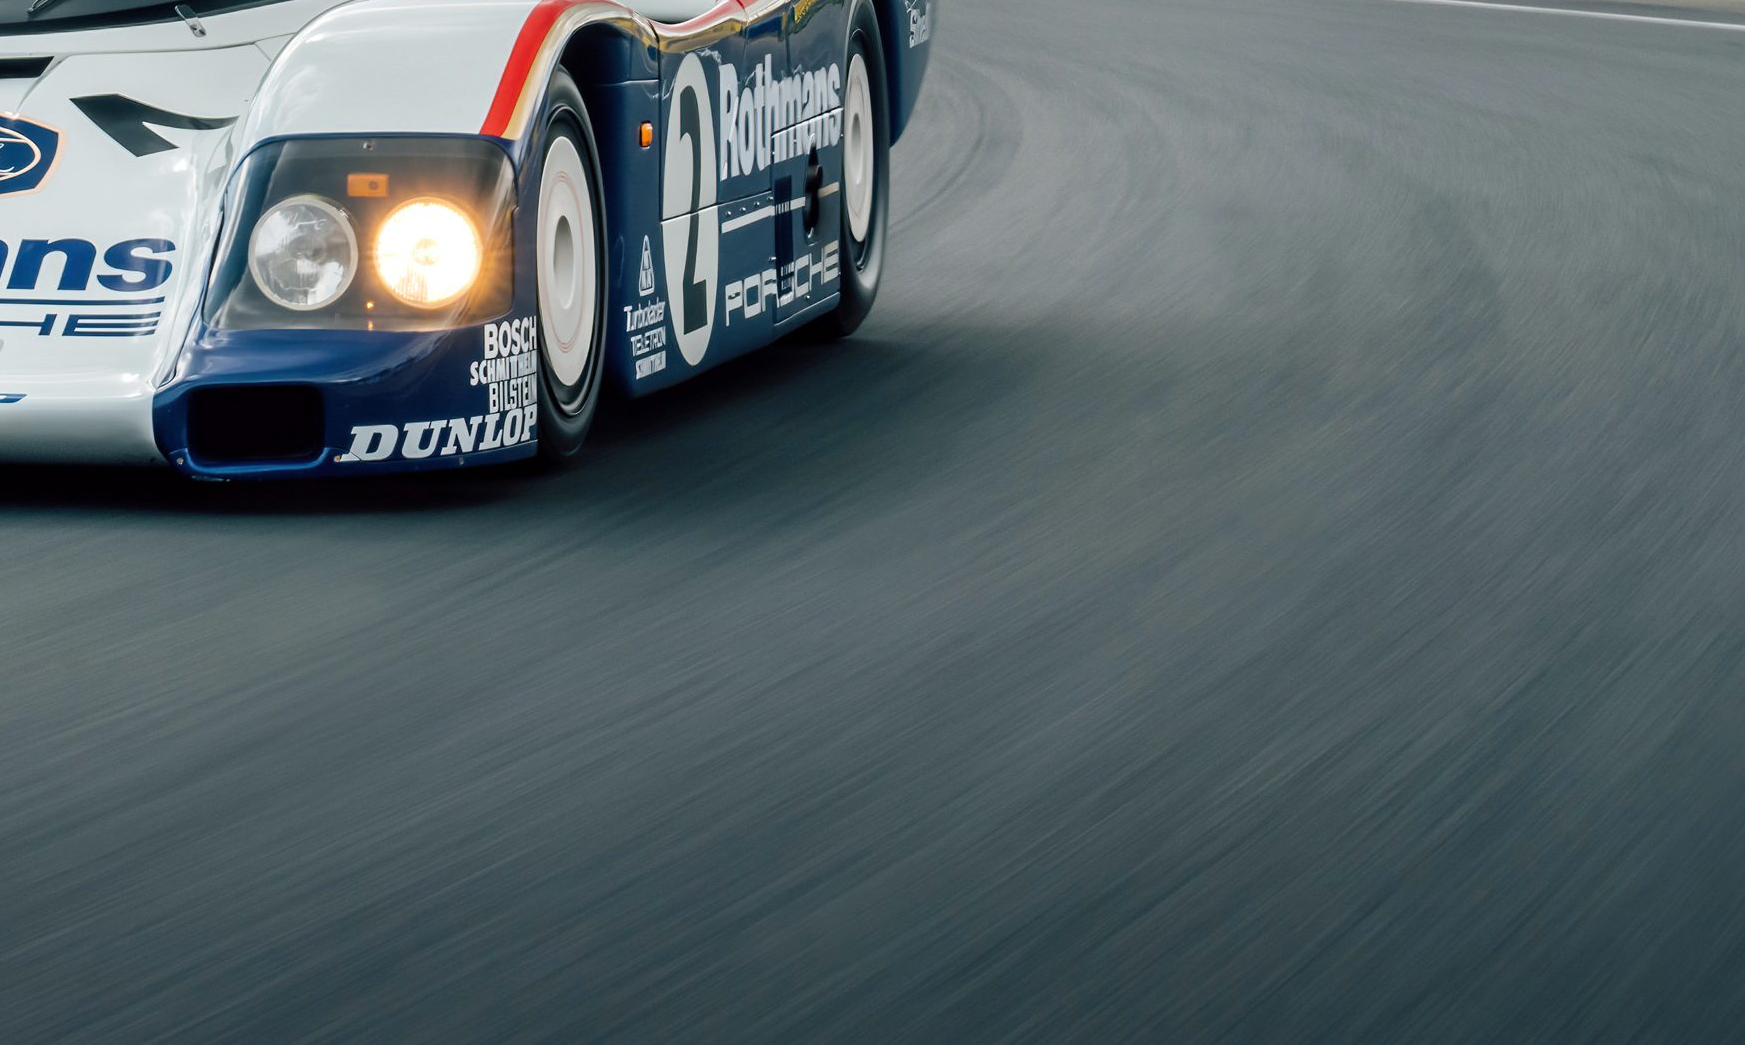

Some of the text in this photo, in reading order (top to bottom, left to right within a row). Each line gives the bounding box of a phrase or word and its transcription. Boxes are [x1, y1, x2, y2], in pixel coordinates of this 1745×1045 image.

[719, 54, 841, 181] Rothmans
[680, 85, 708, 335] 2
[725, 240, 840, 326] PORSCHE
[484, 316, 537, 360] BOSCH
[340, 404, 537, 462] DUNLOP
